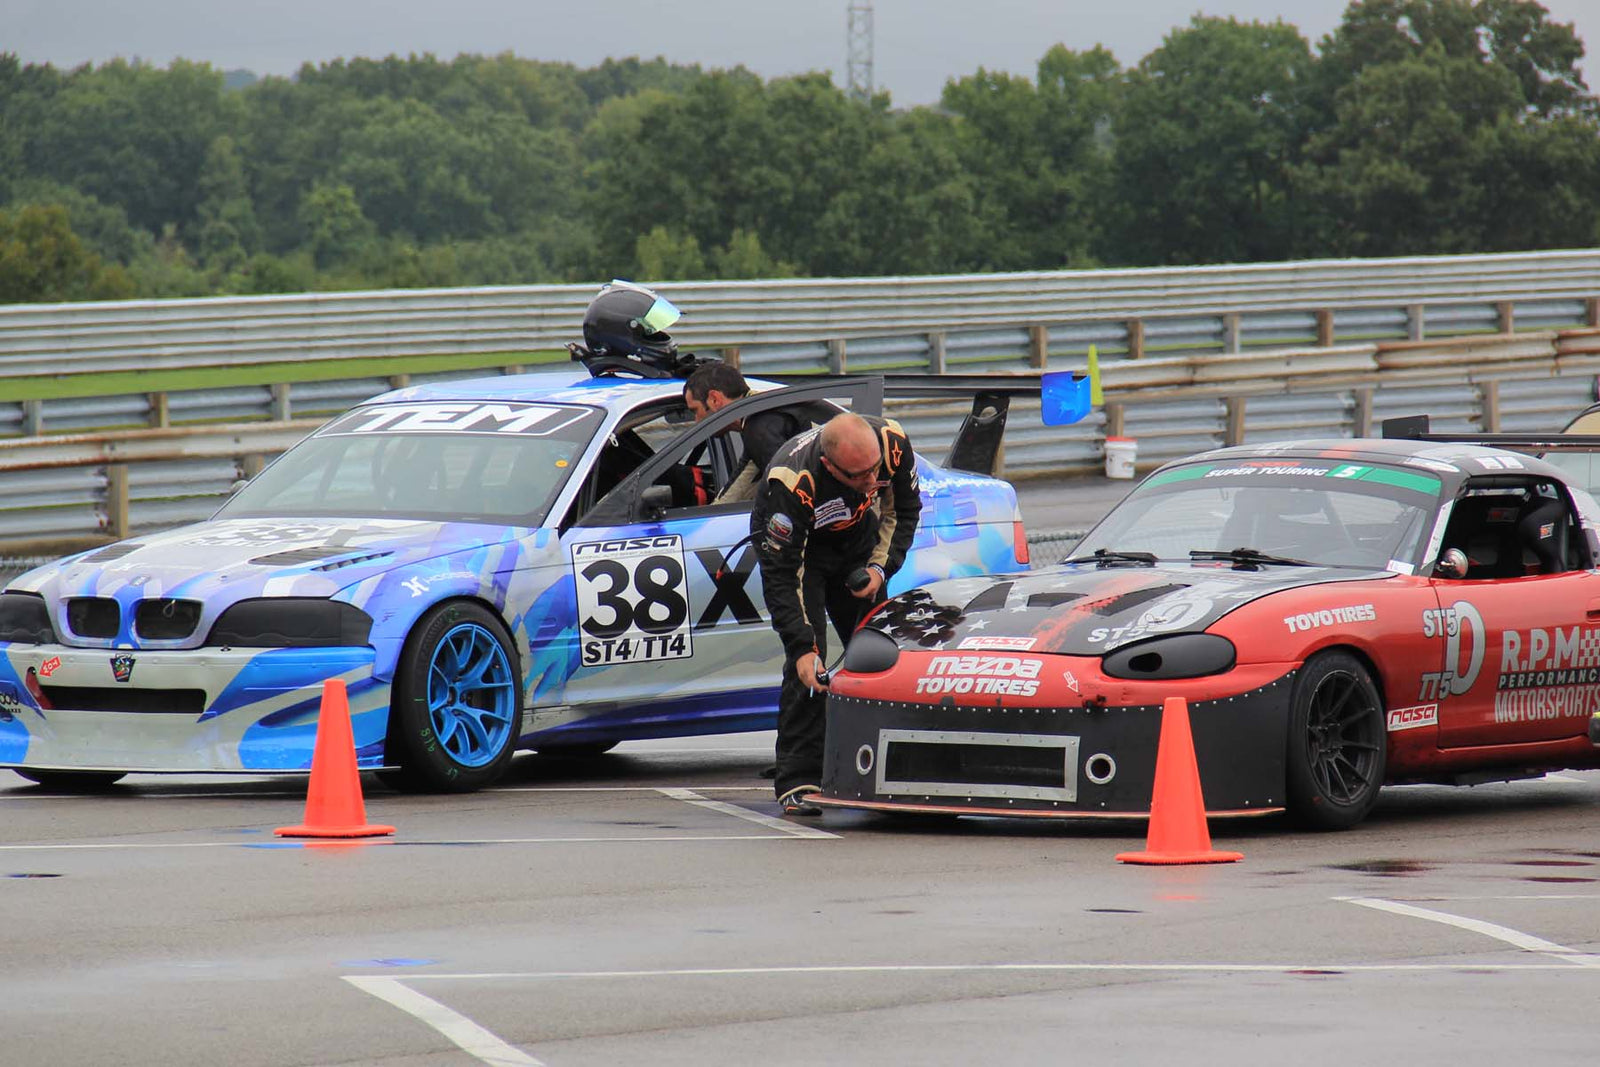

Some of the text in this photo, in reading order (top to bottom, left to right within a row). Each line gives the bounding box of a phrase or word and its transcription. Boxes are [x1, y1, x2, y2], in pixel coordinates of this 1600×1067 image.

[353, 404, 562, 432] TEM
[1205, 467, 1358, 478] SUPER TOURING 5
[575, 536, 678, 555] nasa
[581, 555, 687, 639] 38
[1284, 604, 1376, 633] TOYO TIRES
[1422, 608, 1458, 638] ST5
[1087, 624, 1148, 642] ST5
[584, 633, 685, 664] ST4/TT4
[926, 657, 1042, 678] mazda
[1499, 668, 1600, 688] PERFORMANC
[916, 677, 1040, 697] TOYO TIRES
[1418, 671, 1453, 701] TT5
[1389, 706, 1436, 725] nasa
